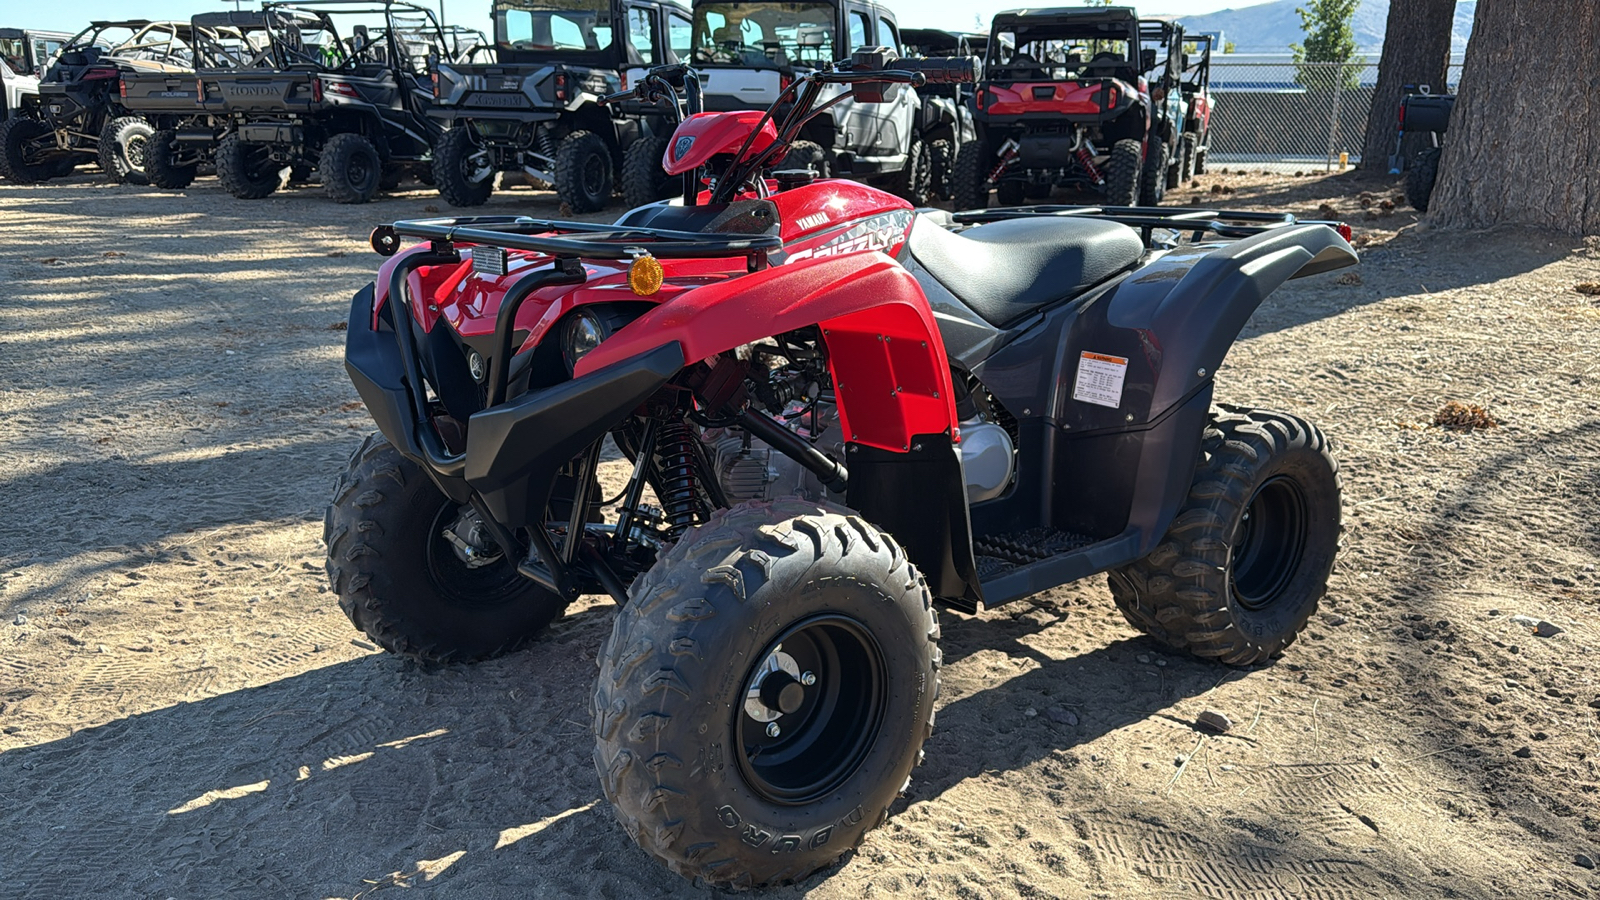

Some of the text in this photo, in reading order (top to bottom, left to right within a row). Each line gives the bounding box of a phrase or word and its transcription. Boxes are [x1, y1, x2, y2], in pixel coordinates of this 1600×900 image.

[229, 86, 281, 96] HONDA
[475, 94, 522, 106] Kawasaki
[796, 211, 830, 231] YAMAHA
